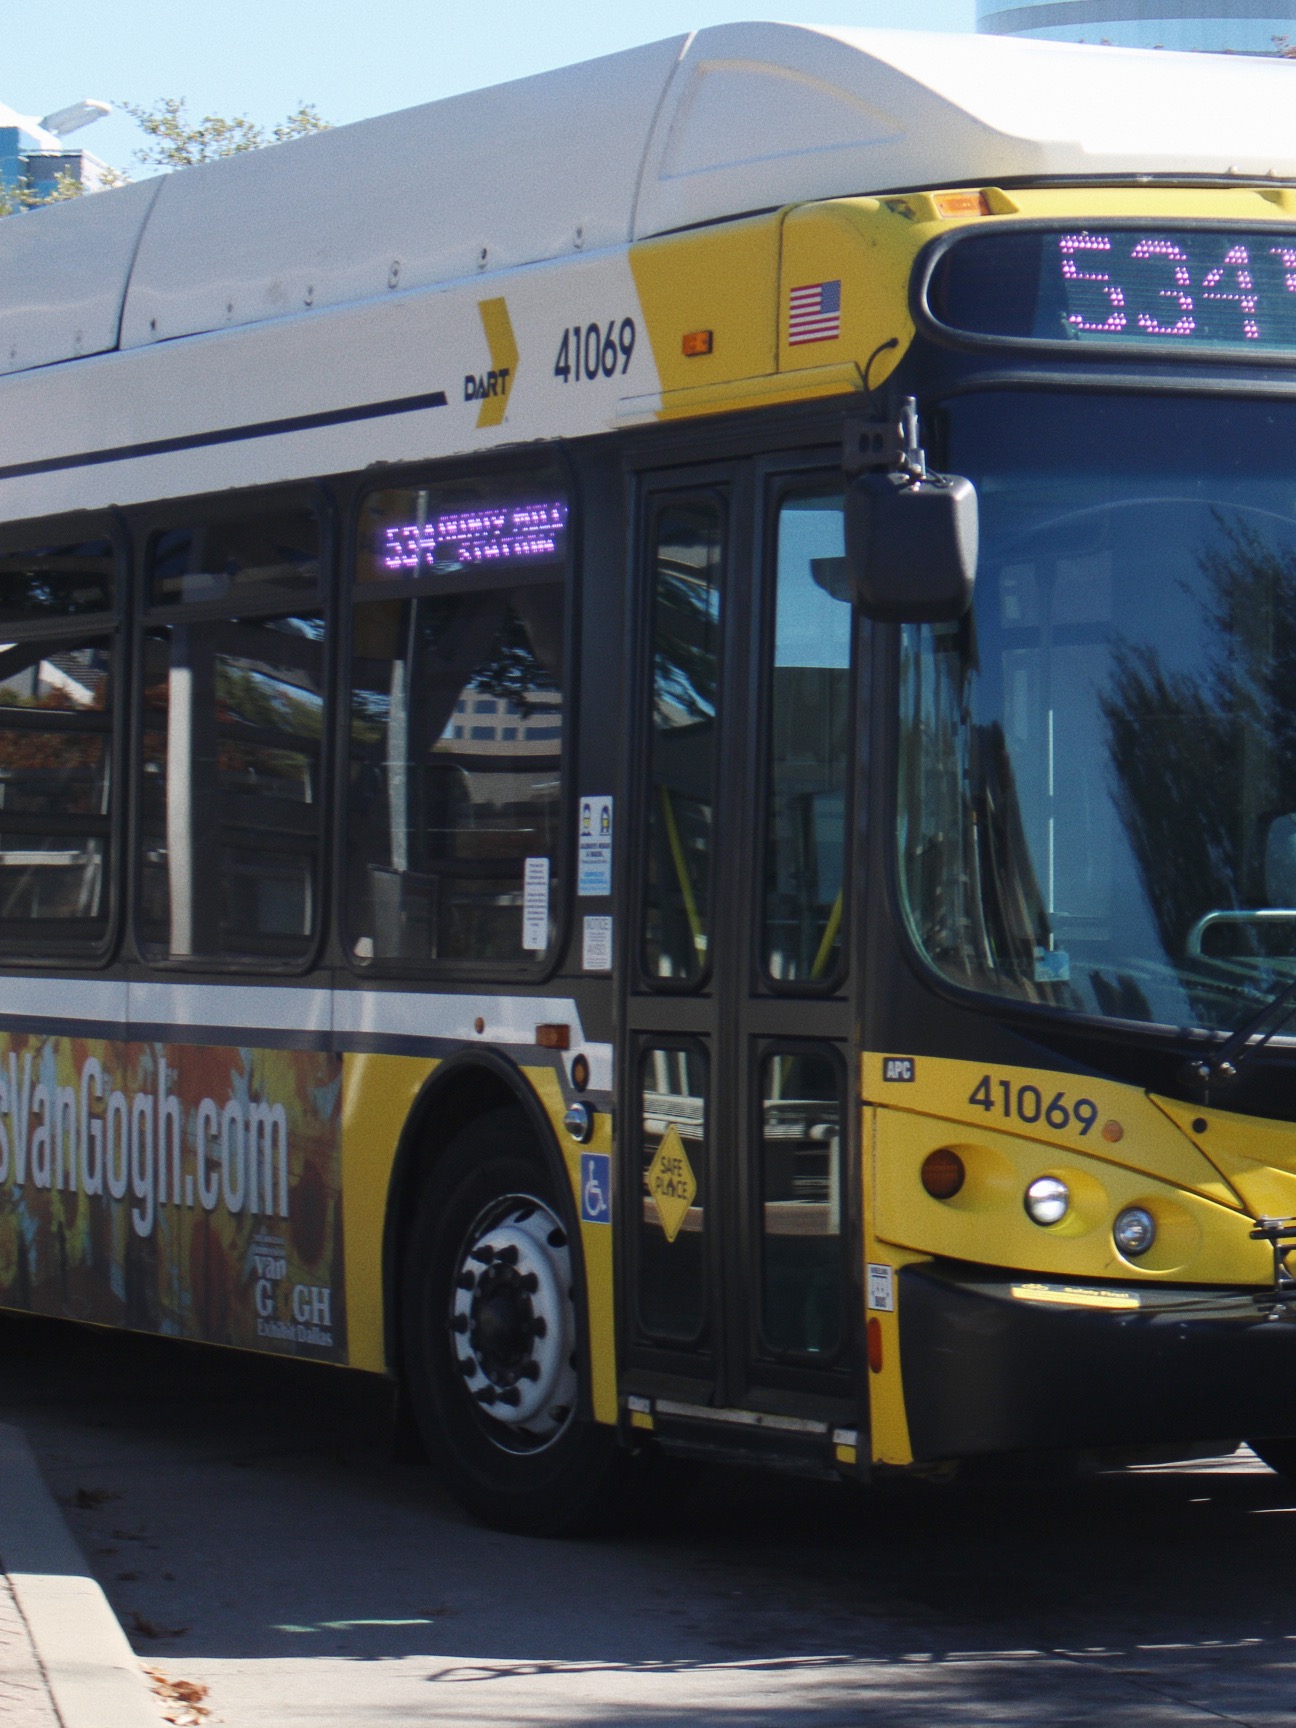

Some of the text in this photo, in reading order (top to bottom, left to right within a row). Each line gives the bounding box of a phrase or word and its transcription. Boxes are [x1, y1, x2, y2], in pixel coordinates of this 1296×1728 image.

[1059, 235, 1260, 338] 534
[554, 317, 636, 384] 41069
[464, 368, 510, 401] DART
[385, 524, 436, 569] 534
[886, 1060, 912, 1079] APC
[968, 1074, 1098, 1136] 41069
[661, 1156, 683, 1177] SAFE
[656, 1176, 690, 1200] PLACE
